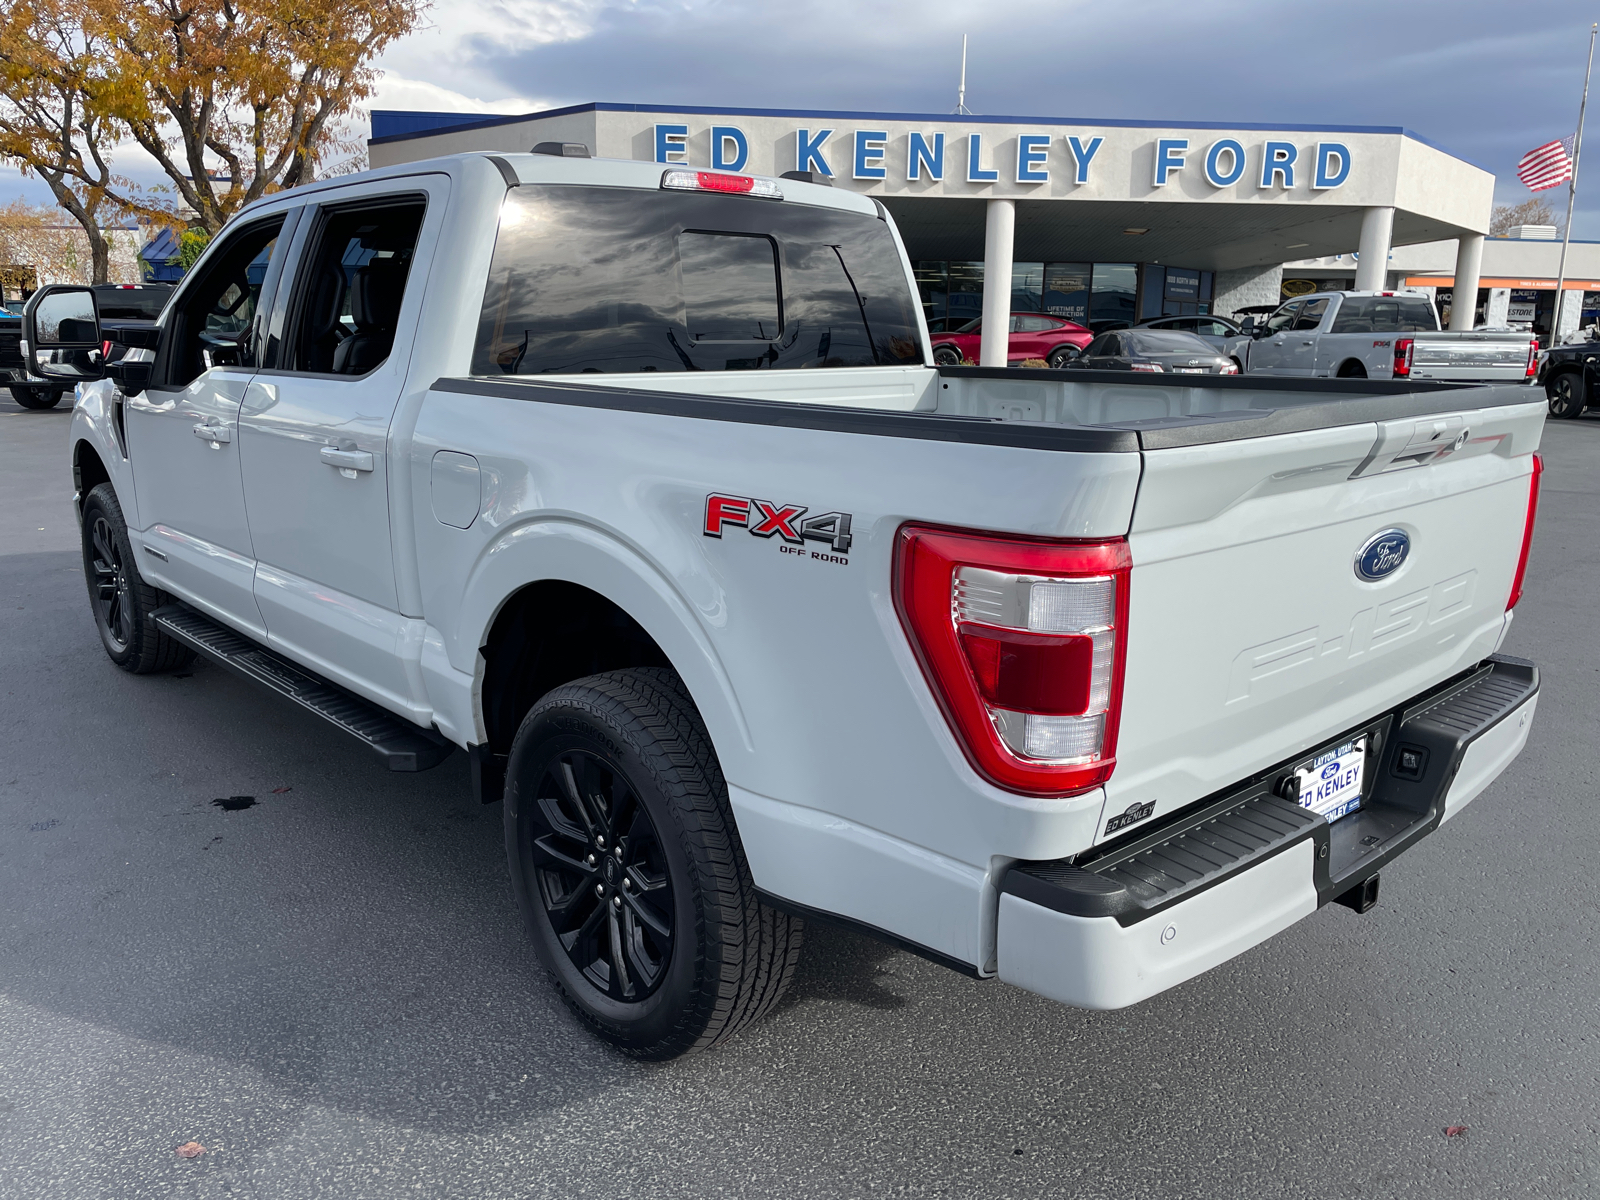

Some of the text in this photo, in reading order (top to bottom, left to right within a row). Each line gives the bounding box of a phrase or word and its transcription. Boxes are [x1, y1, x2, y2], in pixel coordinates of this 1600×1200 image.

[653, 123, 1353, 190] ED KENLEY FORD
[703, 491, 853, 555] FX4
[779, 545, 849, 566] OFF ROAD
[1372, 540, 1404, 573] Ford
[1225, 568, 1478, 707] F-150
[1337, 742, 1352, 757] UTAH
[1316, 765, 1360, 802] KENLEY
[1106, 820, 1119, 832] ED
[1120, 804, 1155, 826] KENLEY
[1324, 803, 1348, 824] ENLEY
